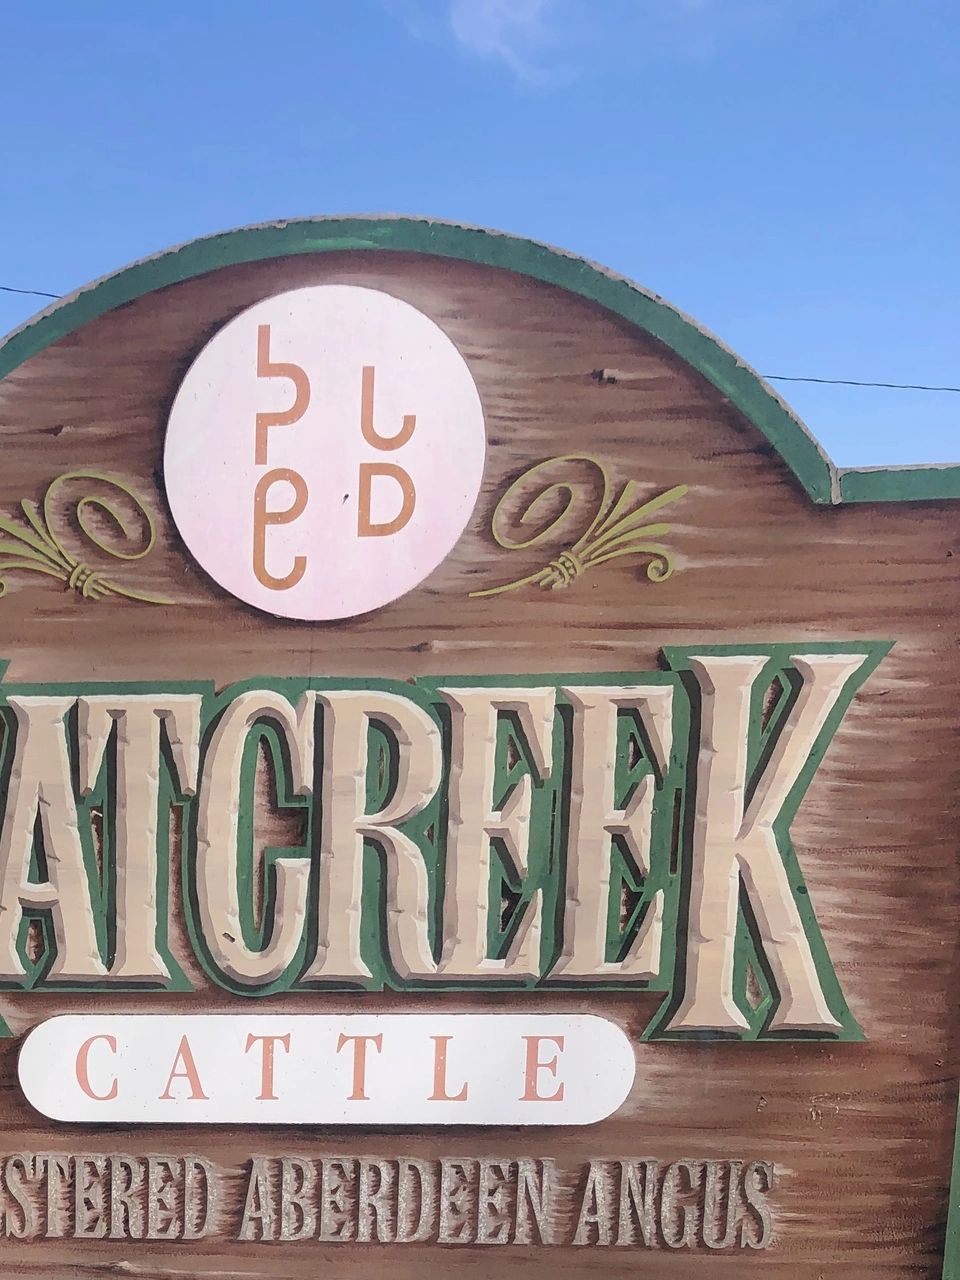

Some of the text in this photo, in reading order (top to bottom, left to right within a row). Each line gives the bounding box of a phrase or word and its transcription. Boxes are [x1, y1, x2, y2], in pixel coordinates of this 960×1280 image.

[74, 1032, 567, 1103] CATTLE
[236, 1156, 558, 1245] ABERDEEN
[572, 1158, 775, 1249] ANGUS
